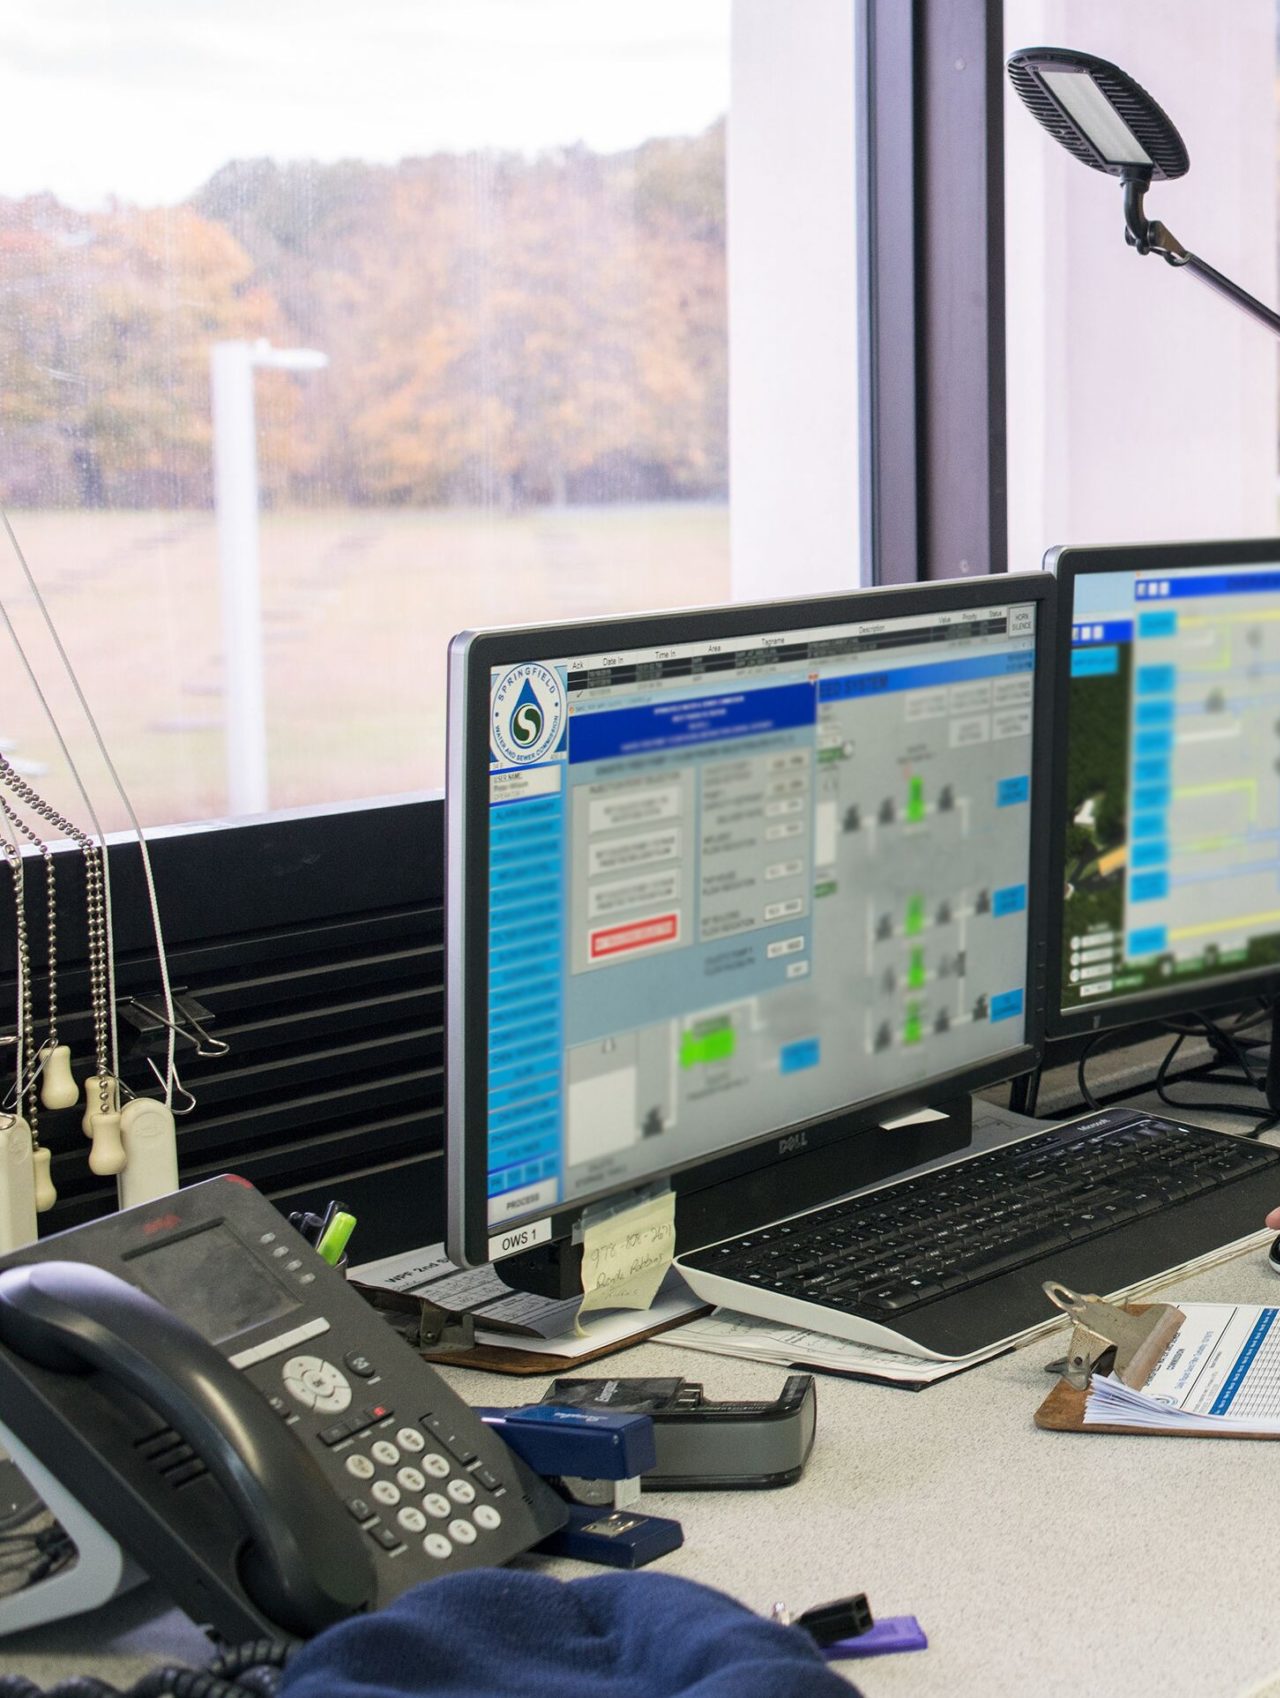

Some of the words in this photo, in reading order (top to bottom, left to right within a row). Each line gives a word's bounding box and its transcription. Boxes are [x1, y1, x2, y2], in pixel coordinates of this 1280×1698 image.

[602, 657, 617, 666] Date
[655, 651, 669, 659] Time
[708, 644, 721, 653] Area
[761, 637, 785, 648] Tagname
[858, 624, 886, 635] Description
[498, 667, 556, 702] SPRINGFIELD
[495, 725, 507, 749] WATER
[505, 748, 516, 759] AND
[516, 751, 535, 761] SEWER
[778, 1133, 808, 1154] DELL
[502, 1231, 528, 1250] OWS
[531, 1229, 536, 1240] 1
